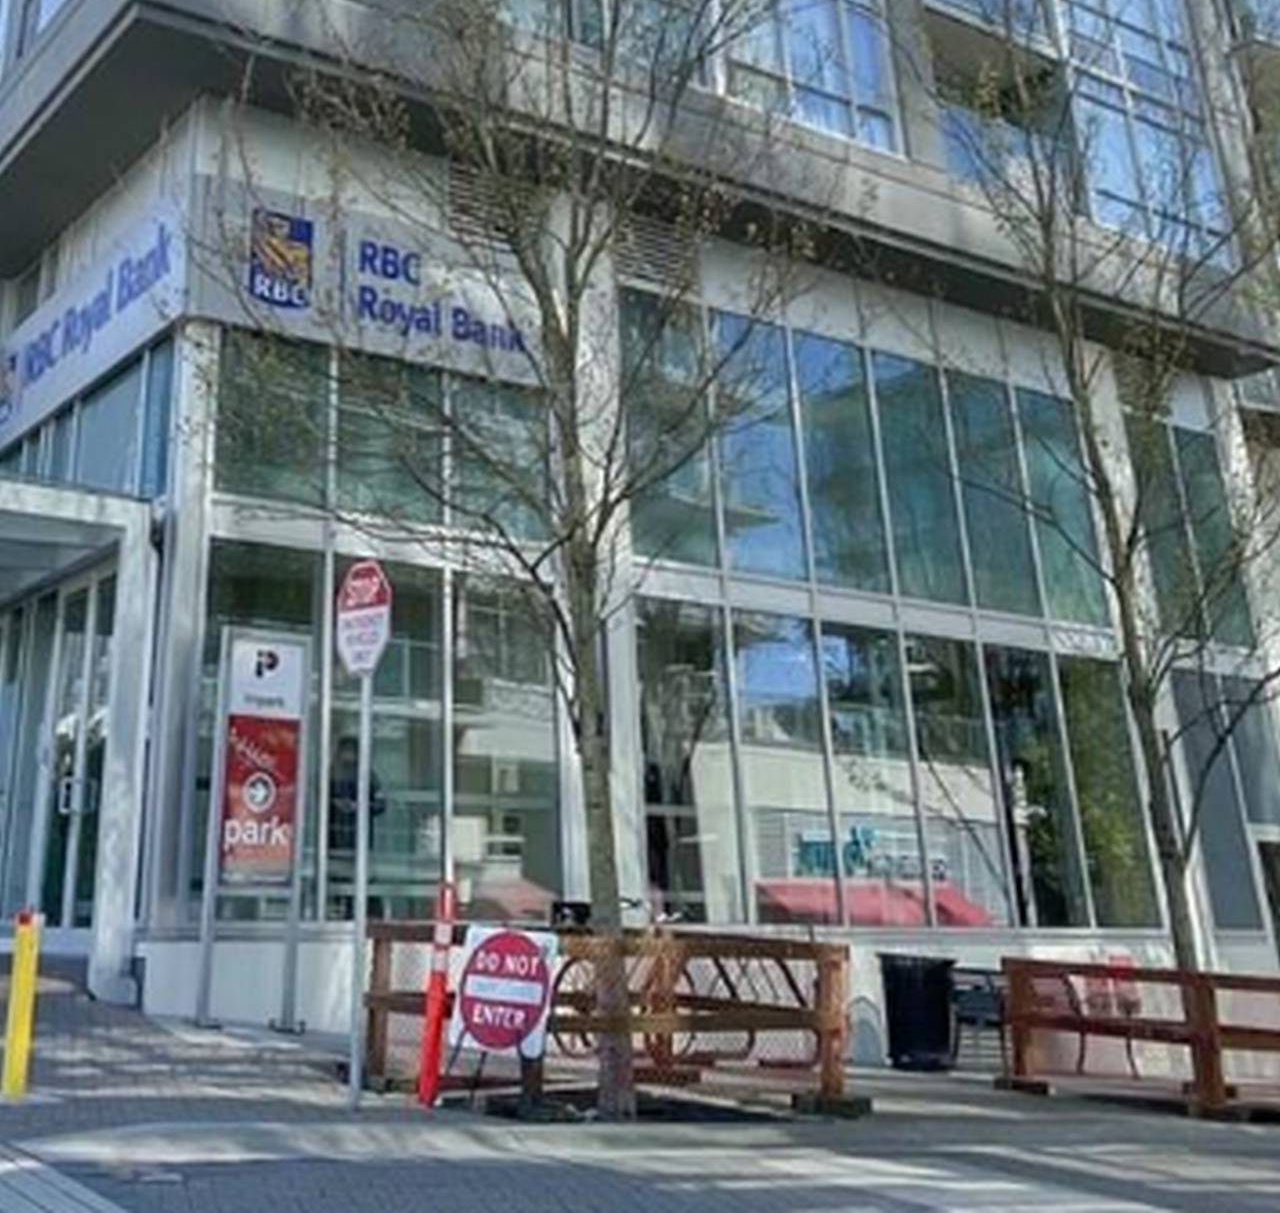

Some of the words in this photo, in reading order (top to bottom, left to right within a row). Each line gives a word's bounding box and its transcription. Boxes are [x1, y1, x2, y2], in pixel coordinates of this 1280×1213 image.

[116, 223, 170, 314] Bank
[358, 240, 423, 286] RBC
[253, 274, 307, 306] RBC
[358, 285, 442, 338] Royal
[224, 816, 290, 852] park
[476, 950, 500, 971] DO
[504, 953, 540, 977] NOT
[472, 1003, 526, 1028] ENTER
